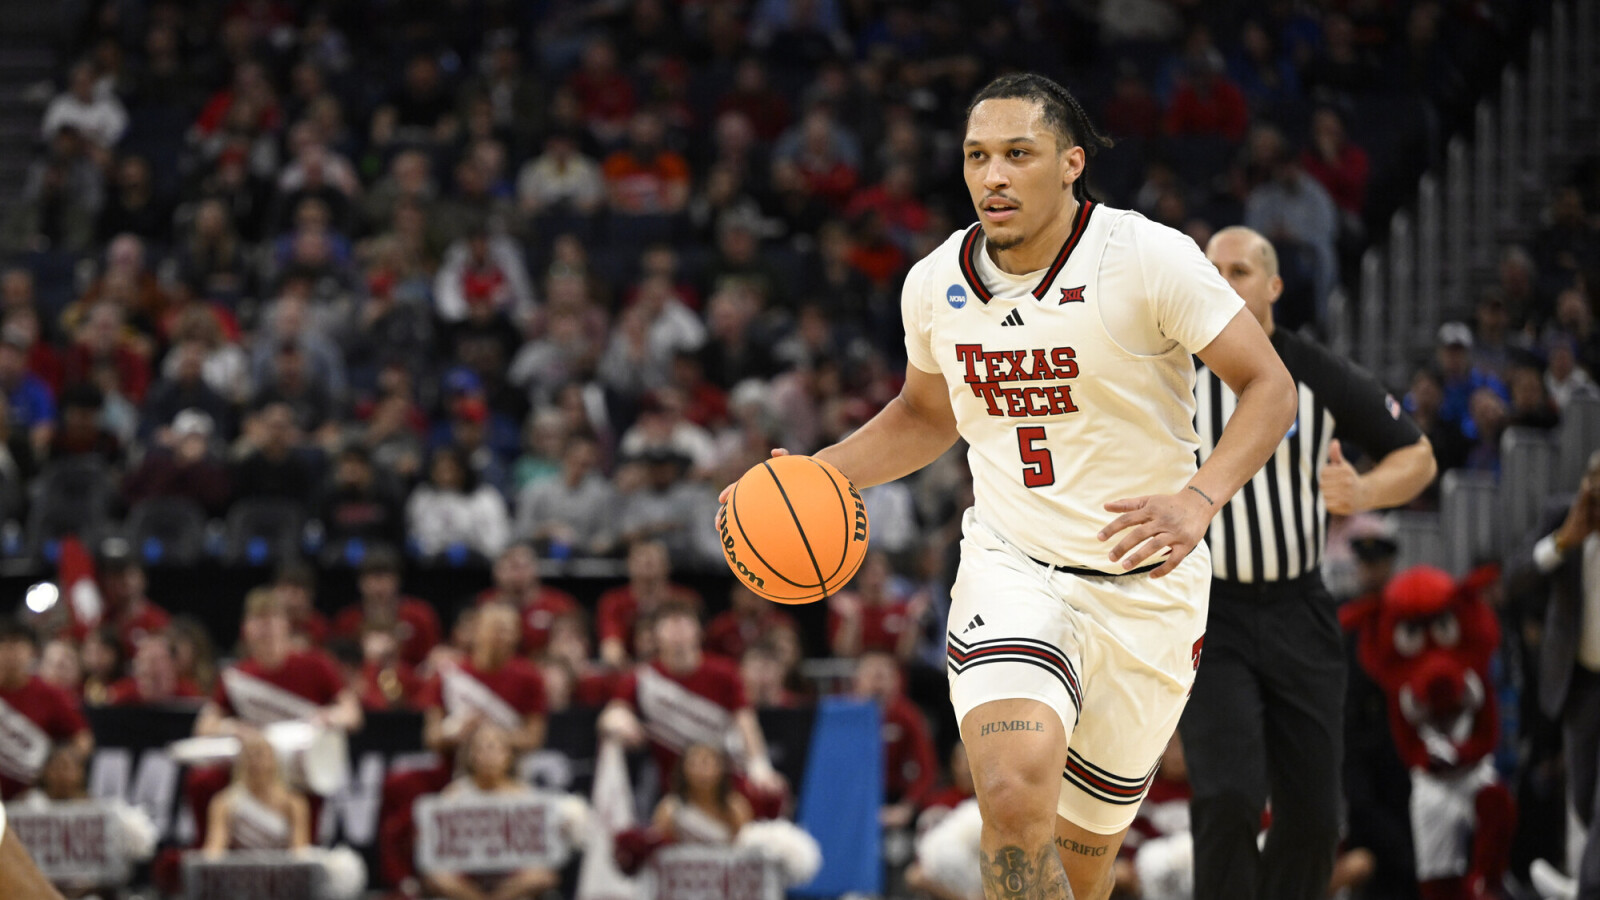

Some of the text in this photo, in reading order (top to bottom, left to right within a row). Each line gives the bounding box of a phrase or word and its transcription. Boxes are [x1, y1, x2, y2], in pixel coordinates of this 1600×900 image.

[955, 344, 1080, 383] TEXAS
[970, 382, 1079, 417] TECH
[1016, 426, 1055, 488] 5
[981, 720, 1045, 737] HUMBLE
[1054, 835, 1109, 857] ACRIFICE
